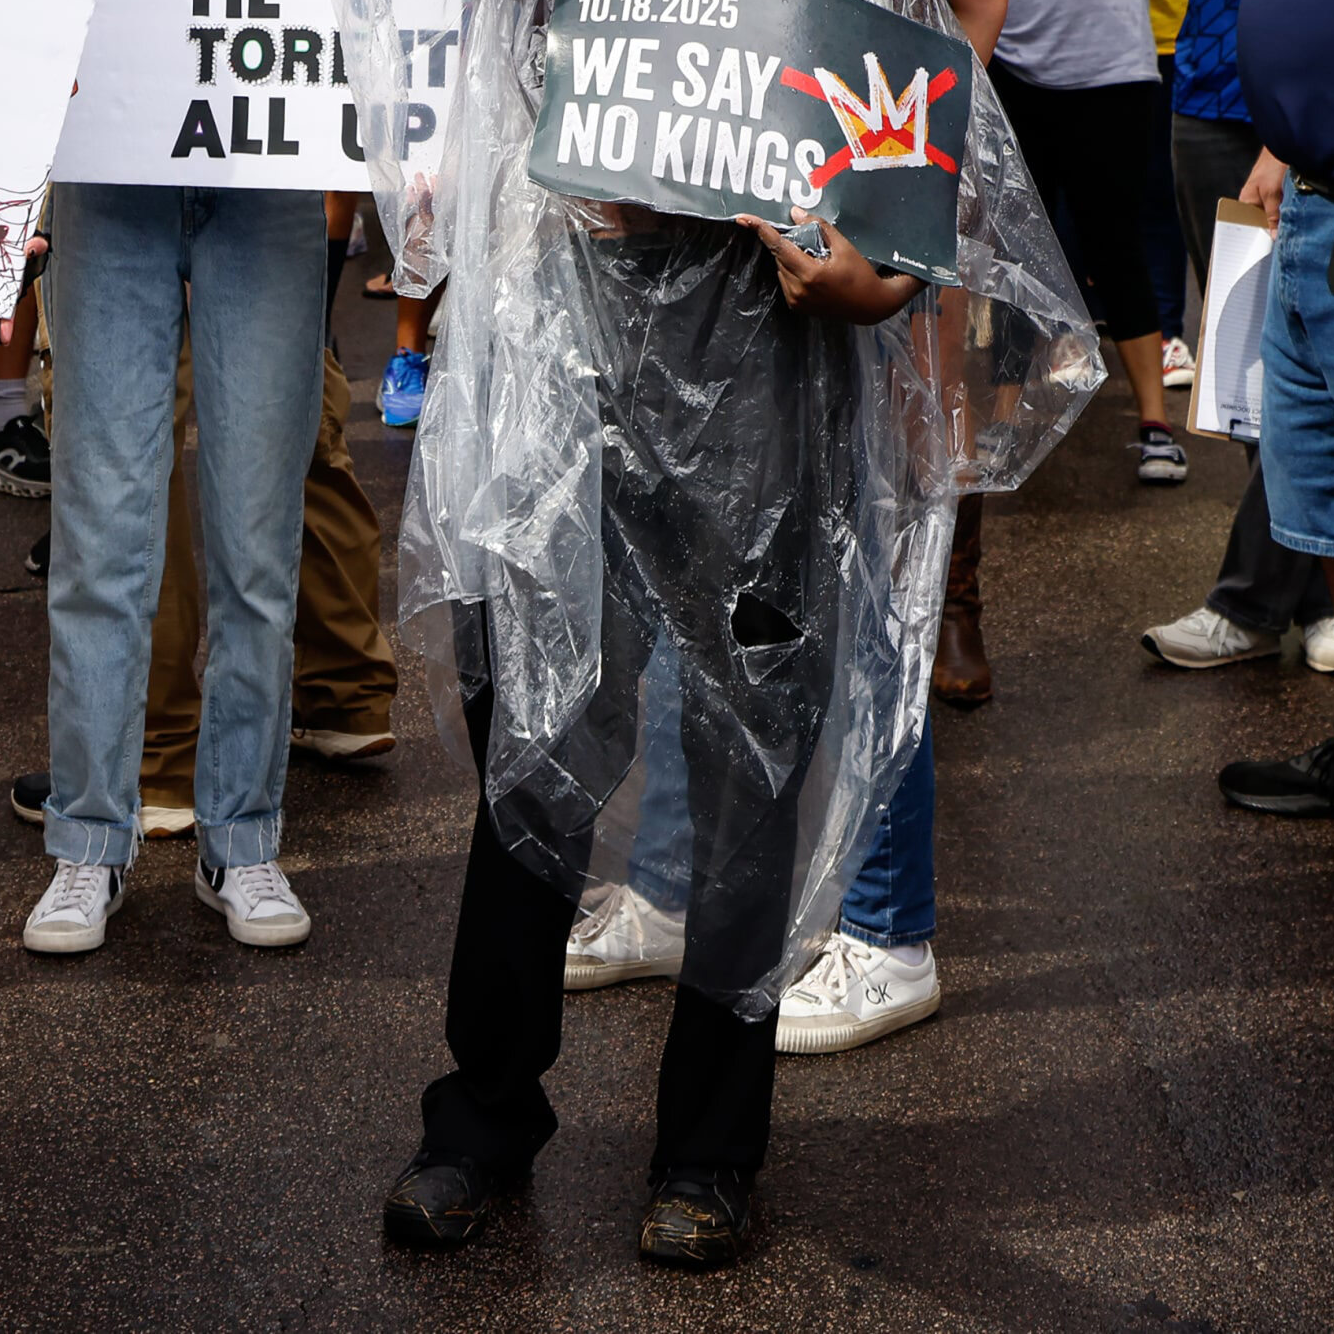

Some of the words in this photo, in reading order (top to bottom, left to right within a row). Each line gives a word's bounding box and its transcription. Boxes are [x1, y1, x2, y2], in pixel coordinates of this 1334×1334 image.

[572, 37, 660, 101] WE
[672, 41, 782, 121] SAY
[171, 96, 300, 159] ALL
[341, 102, 437, 163] UP
[557, 102, 639, 172] NO
[651, 110, 827, 209] KINGS
[866, 982, 893, 1005] CK
